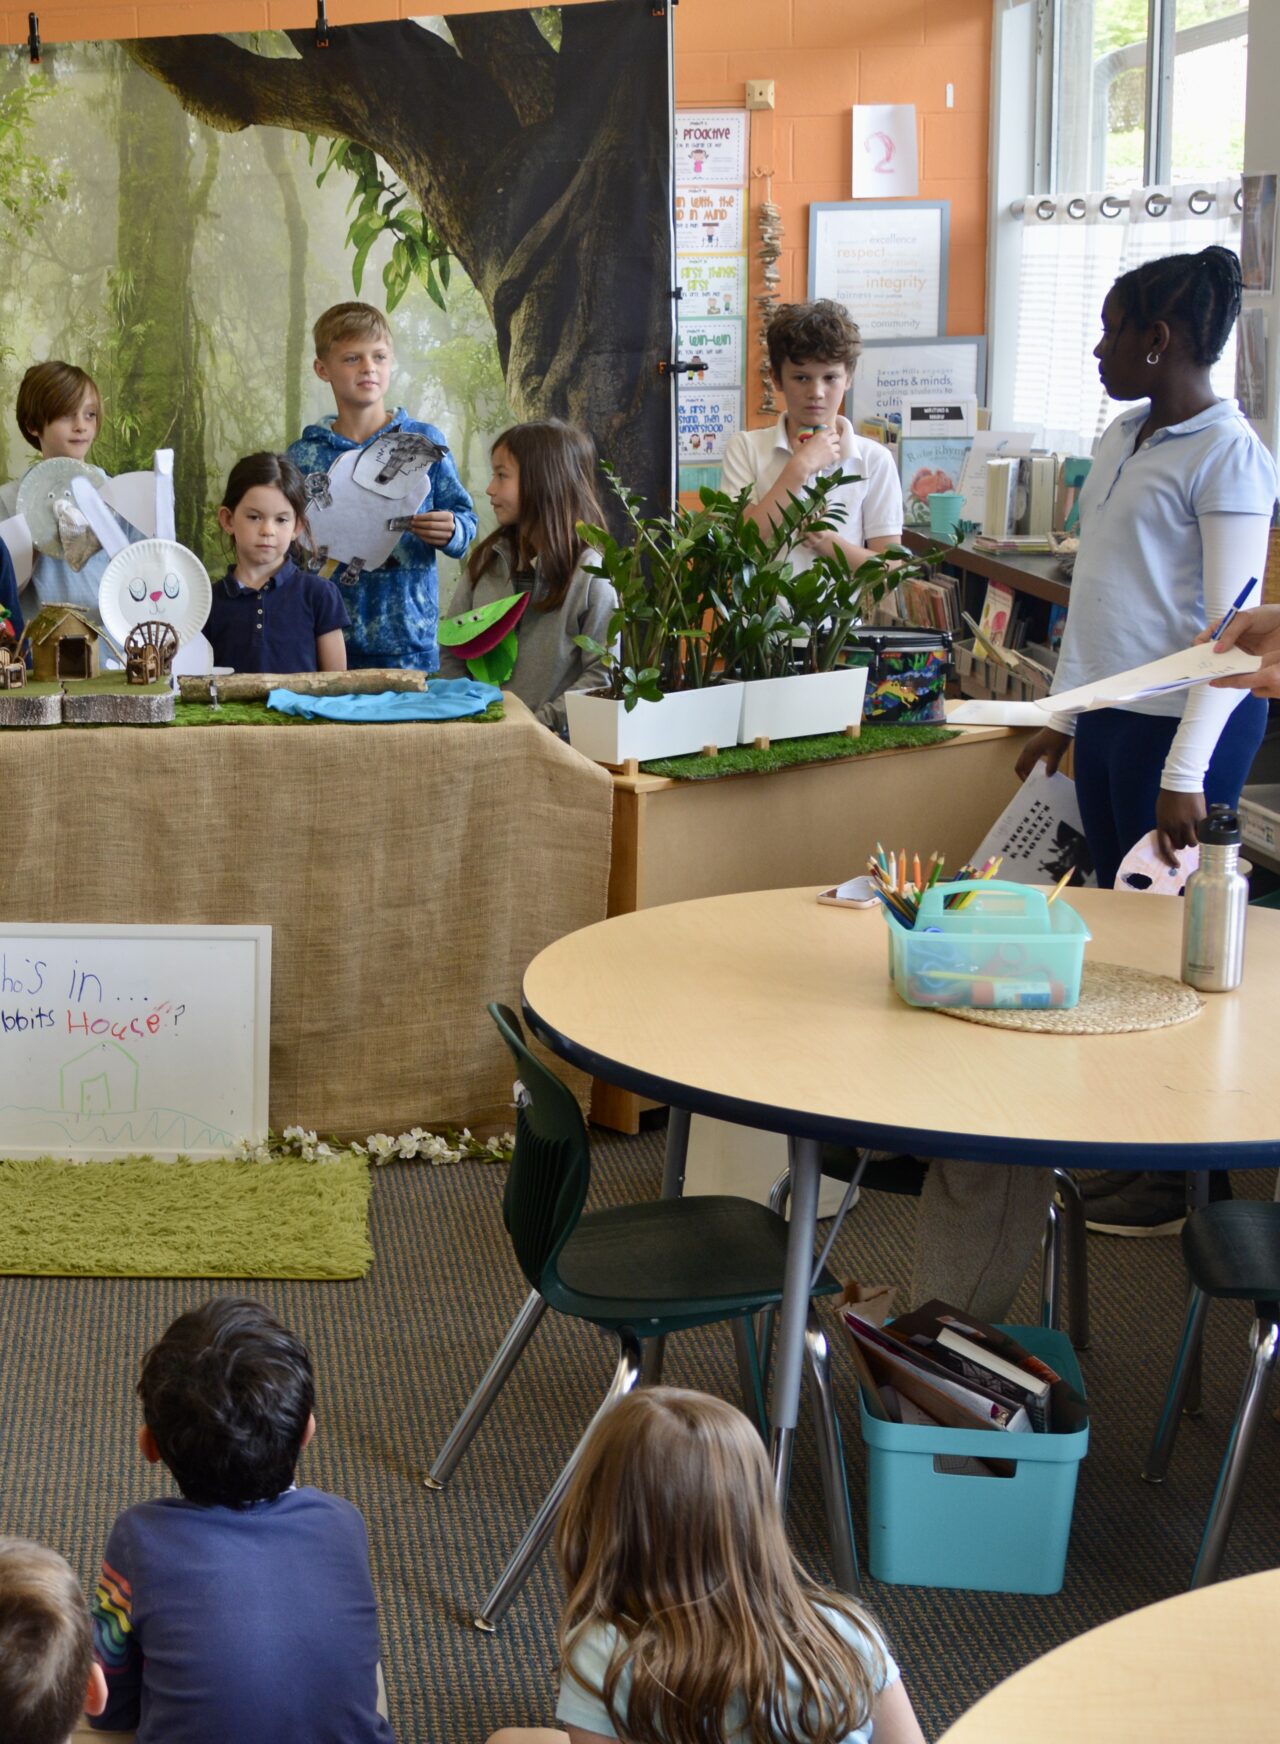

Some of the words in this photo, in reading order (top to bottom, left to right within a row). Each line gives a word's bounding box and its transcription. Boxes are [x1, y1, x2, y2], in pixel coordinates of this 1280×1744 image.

[864, 131, 896, 174] 2
[869, 233, 917, 245] excellence
[837, 247, 886, 260] respect
[865, 274, 927, 293] integrity
[837, 290, 872, 299] fairness
[871, 320, 920, 330] community
[877, 376, 909, 388] hearts
[911, 376, 918, 386] &
[920, 374, 953, 386] minds,
[876, 396, 903, 407] cultiv
[1002, 815, 1030, 853] WHO'S
[1029, 800, 1041, 815] IN
